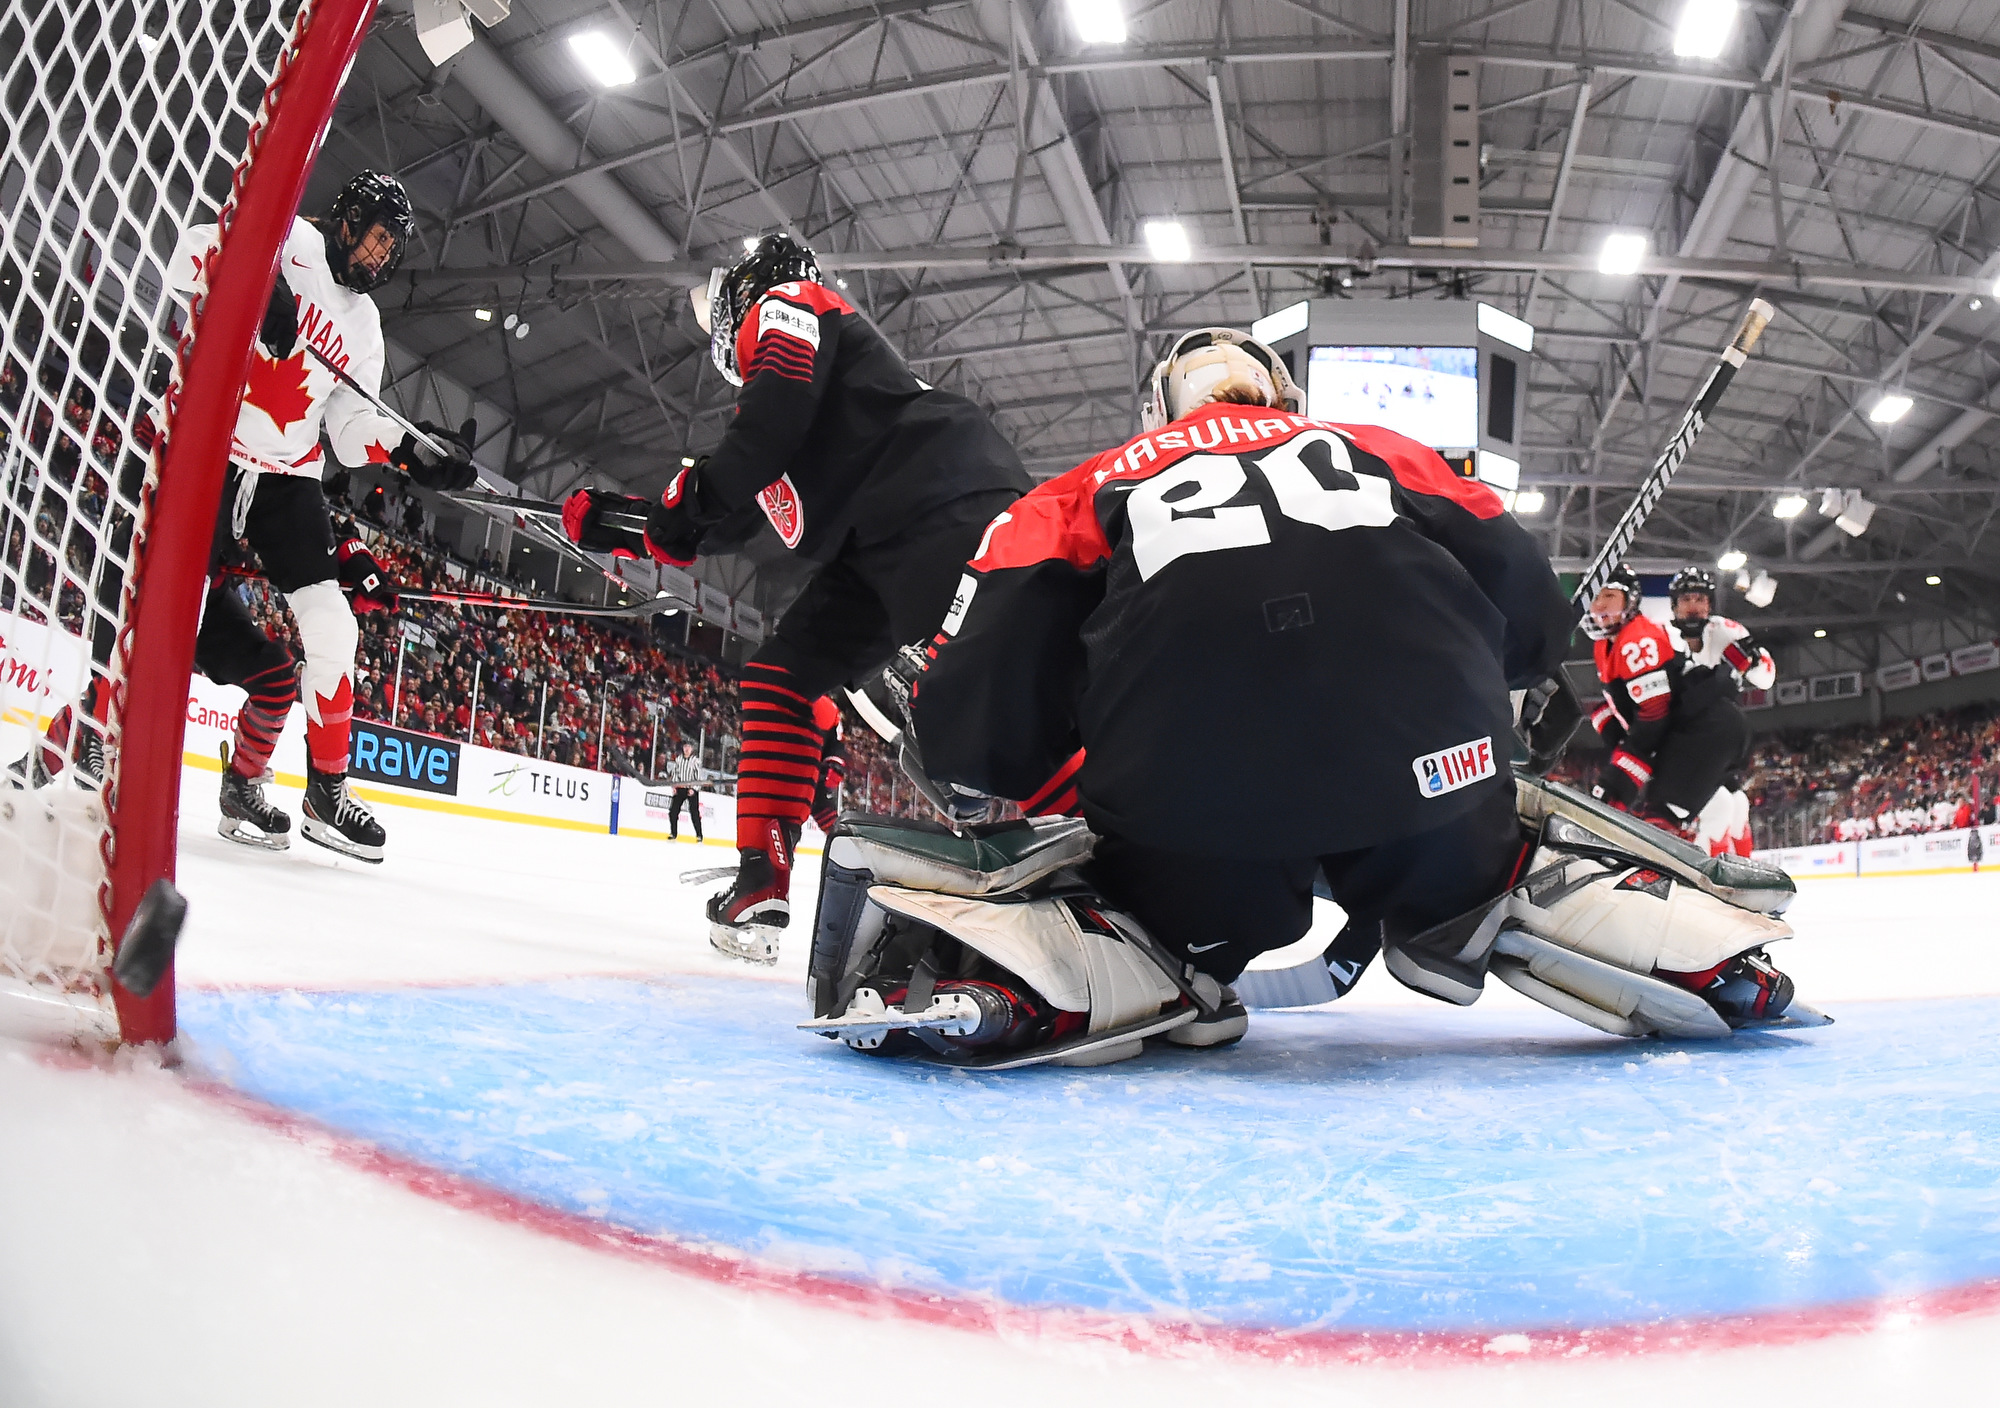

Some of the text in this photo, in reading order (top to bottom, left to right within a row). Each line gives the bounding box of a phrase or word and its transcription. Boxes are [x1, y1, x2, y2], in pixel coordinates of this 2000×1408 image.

[1621, 637, 1659, 673] 23
[1441, 742, 1490, 786] IIHF
[530, 772, 590, 801] TELUS
[770, 828, 786, 865] CCM
